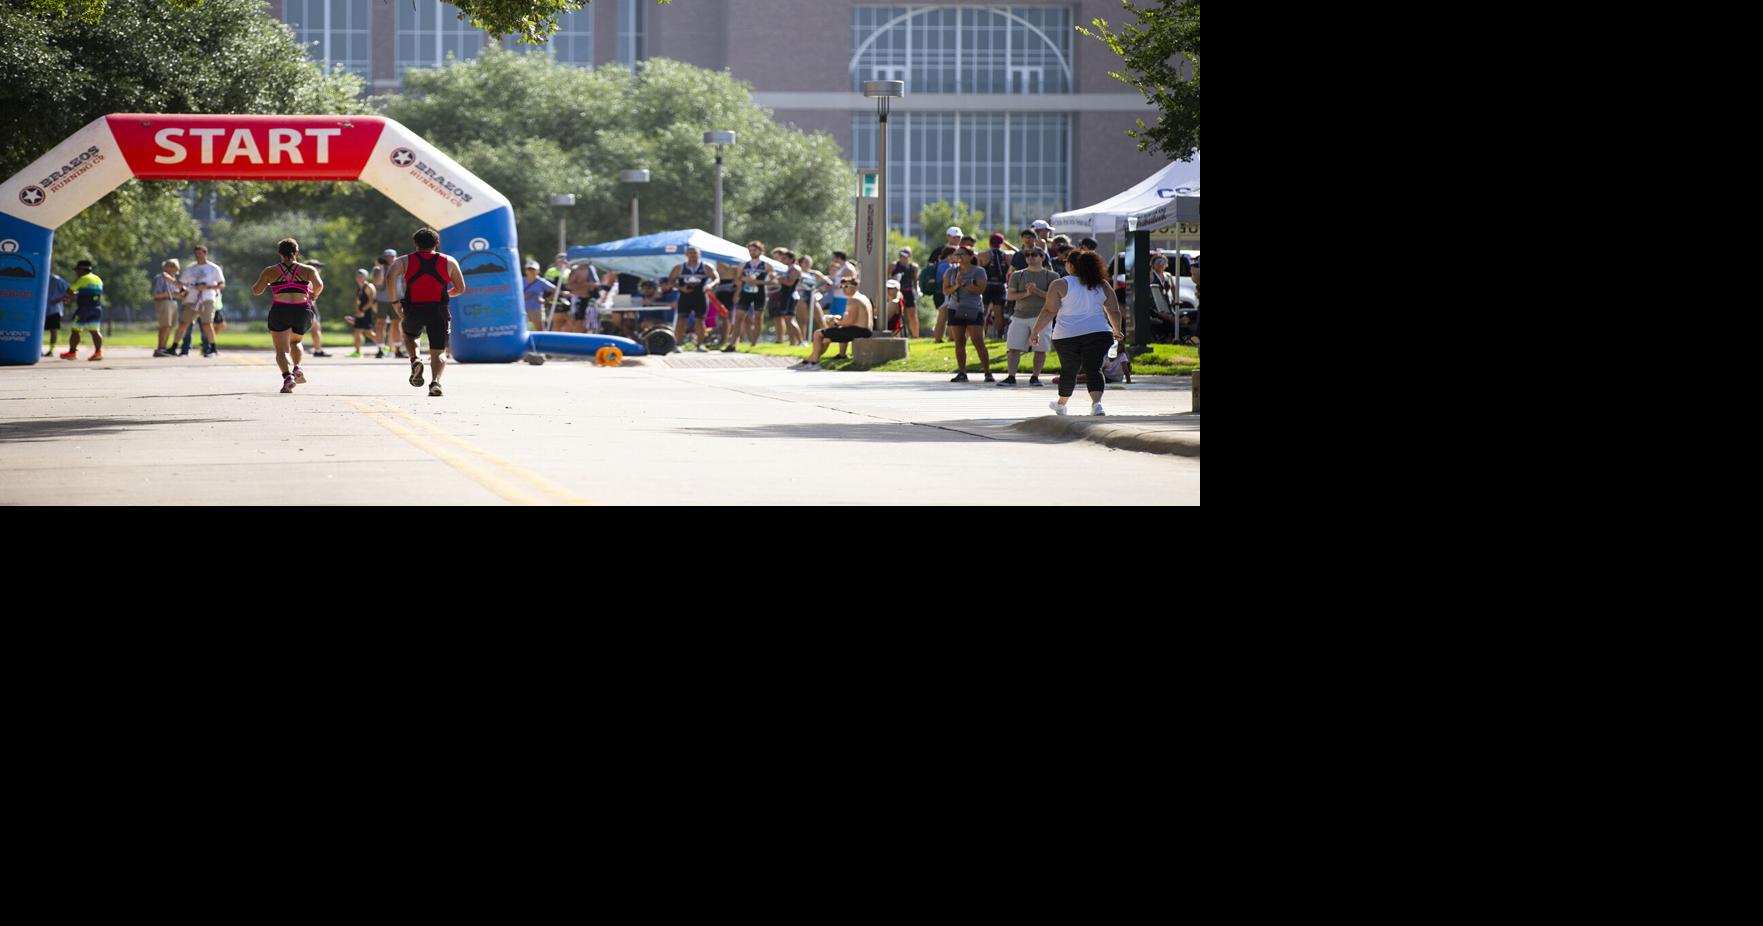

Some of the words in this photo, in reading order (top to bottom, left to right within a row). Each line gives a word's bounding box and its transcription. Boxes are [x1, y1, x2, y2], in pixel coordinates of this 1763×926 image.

[154, 128, 341, 164] START
[39, 145, 99, 188] BRAZOS
[50, 162, 93, 193] RUNNING
[415, 161, 473, 202] BRAZOS
[410, 170, 450, 200] RUNNING
